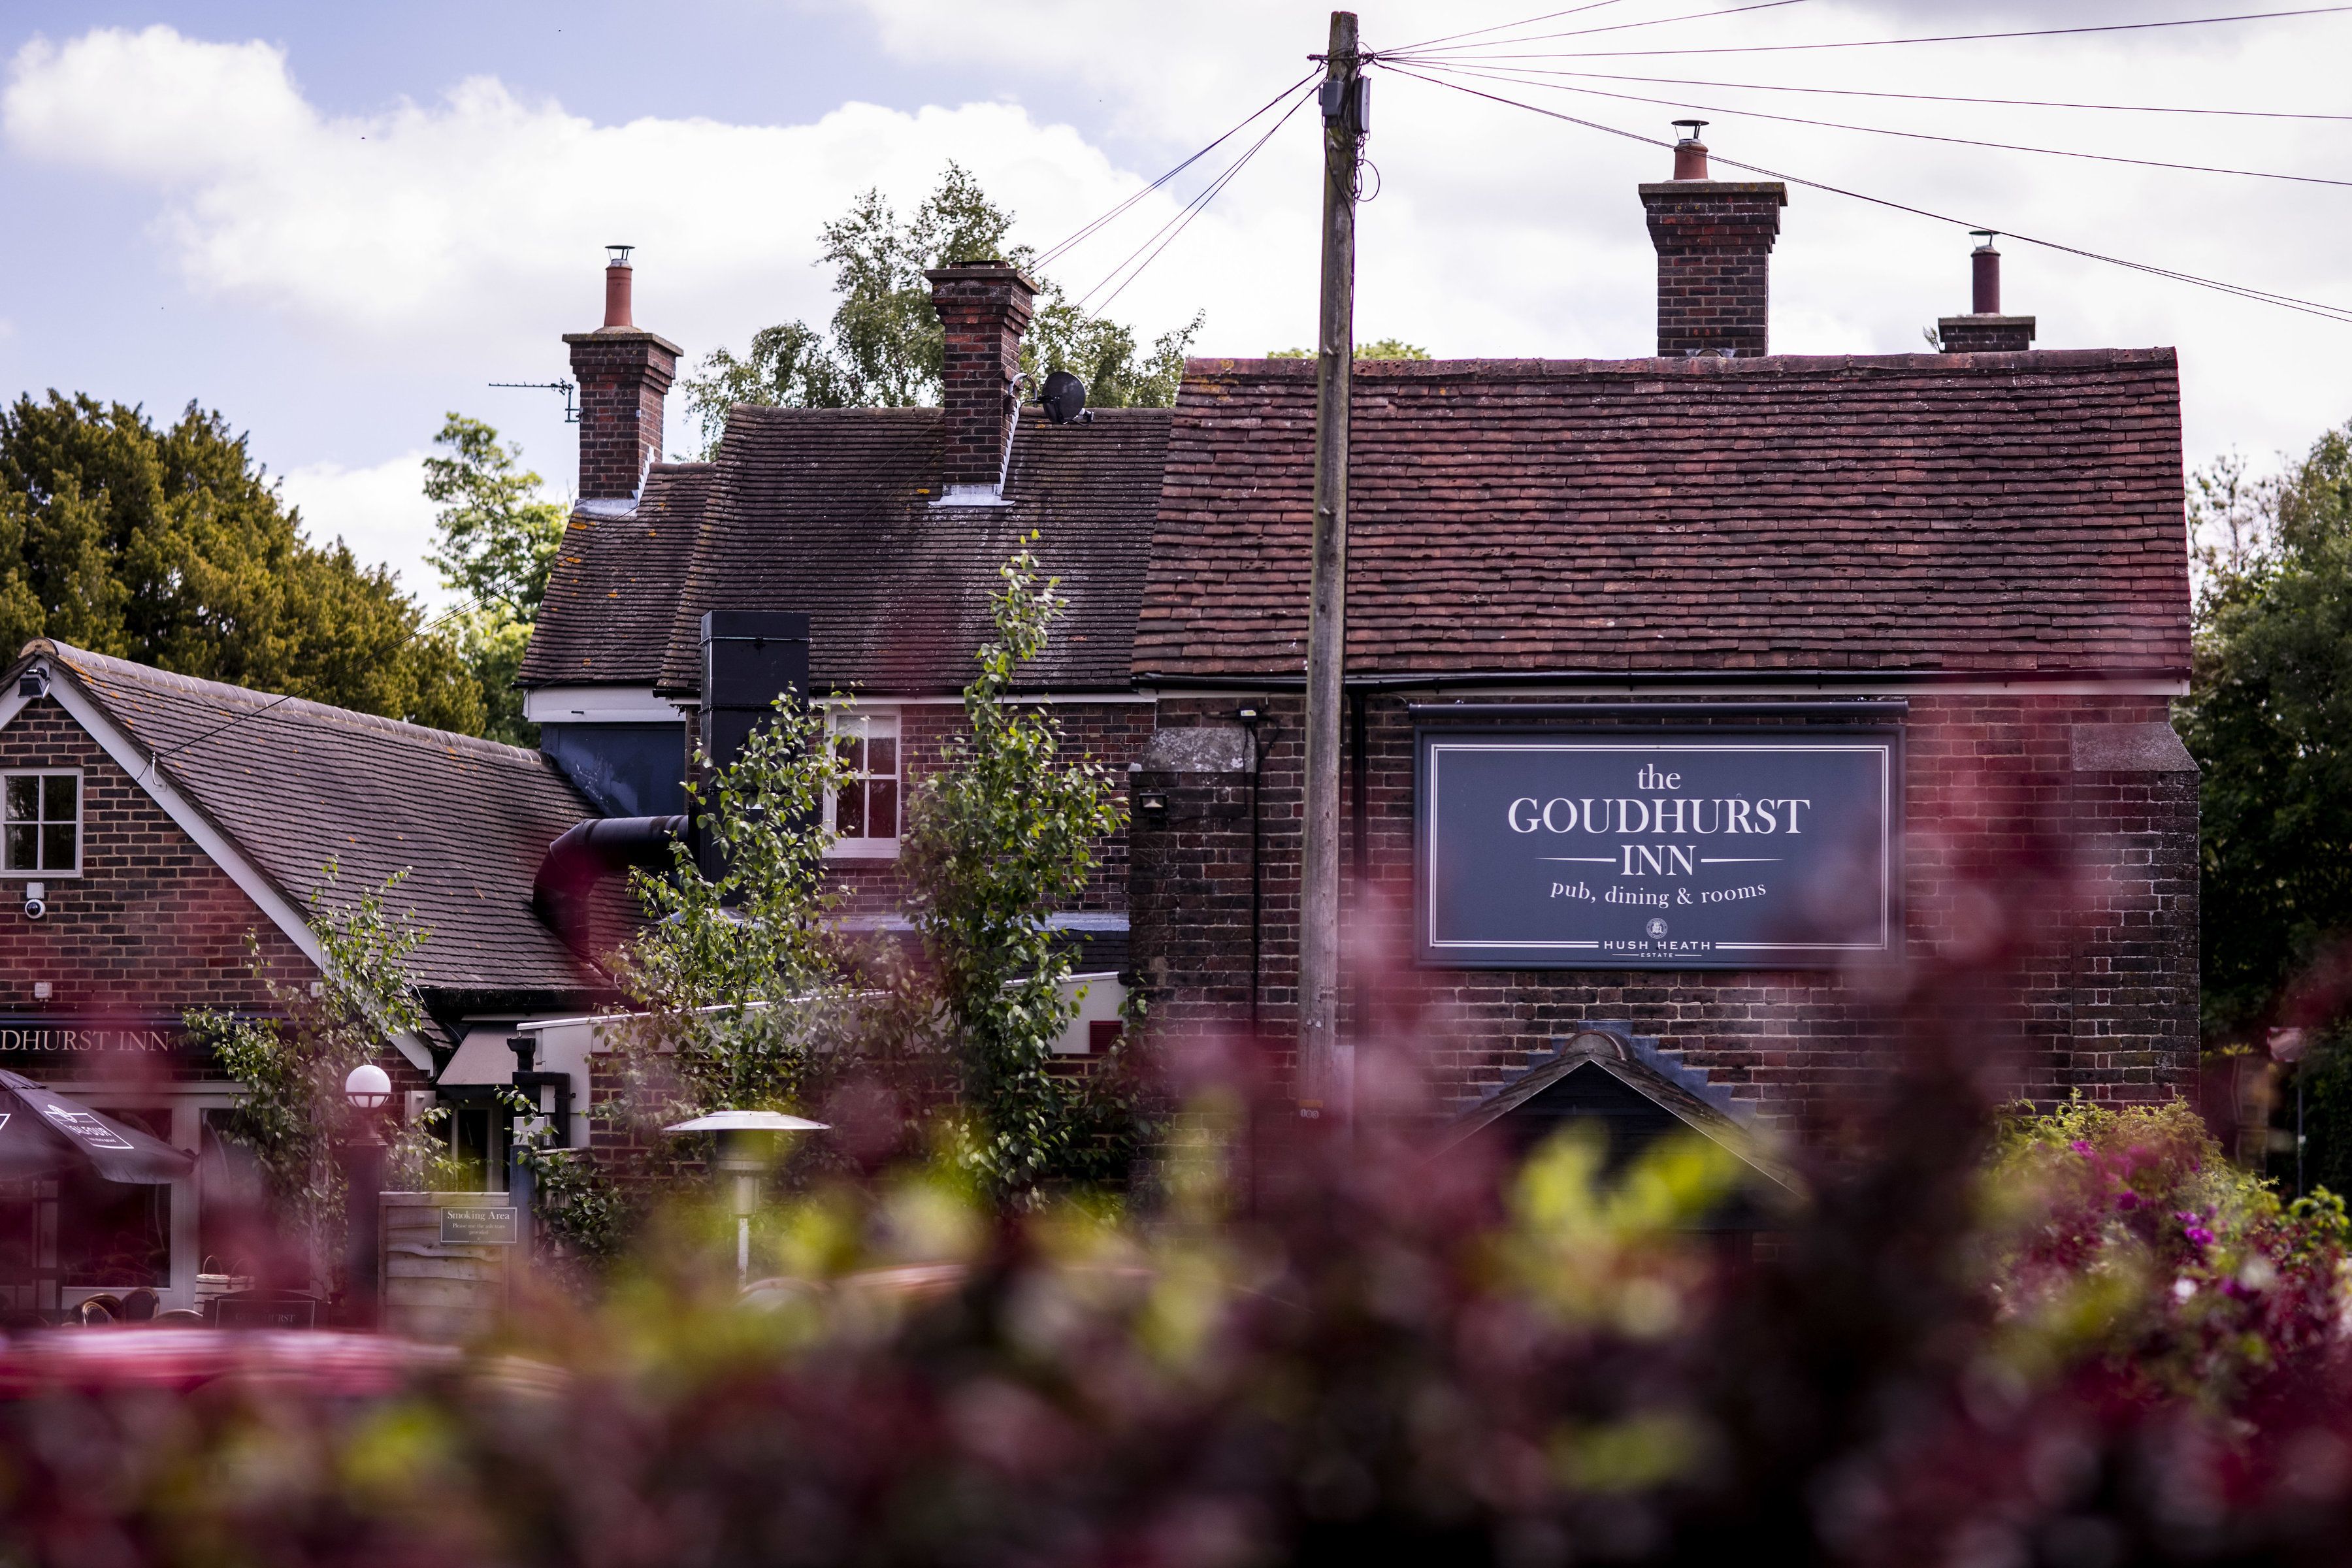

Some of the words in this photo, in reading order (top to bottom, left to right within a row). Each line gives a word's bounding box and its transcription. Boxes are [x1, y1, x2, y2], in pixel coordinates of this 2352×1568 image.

[1637, 763, 1681, 790] the
[1508, 797, 1810, 834] GOUDHURST
[1620, 845, 1697, 875] INN
[1550, 881, 1596, 904] pub,
[1605, 885, 1670, 909] dining
[1676, 887, 1693, 905] &
[1701, 883, 1767, 903] rooms
[1604, 941, 1648, 949] HUSH
[1658, 941, 1710, 950] HEATH
[0, 1030, 110, 1051] DHURST
[118, 1030, 171, 1051] INN
[447, 1210, 485, 1221] Smoking
[488, 1211, 510, 1220] Area
